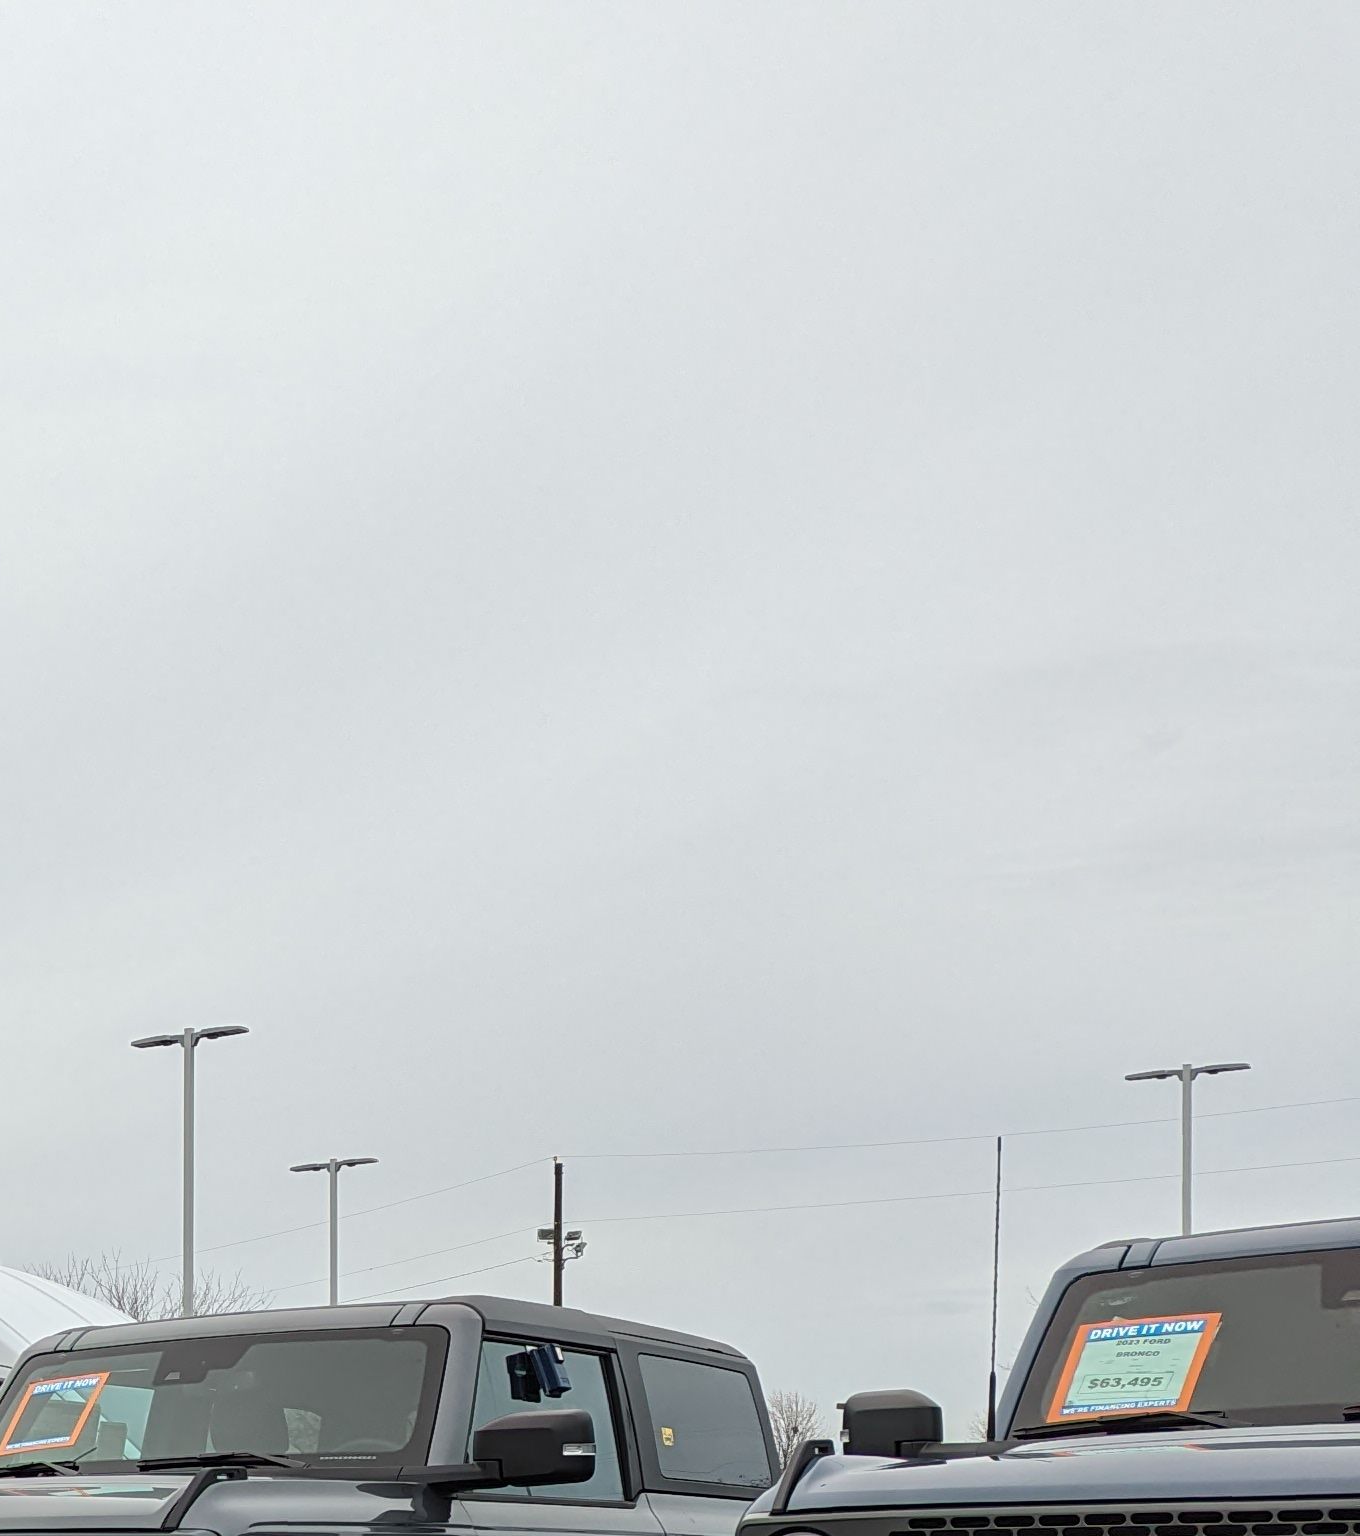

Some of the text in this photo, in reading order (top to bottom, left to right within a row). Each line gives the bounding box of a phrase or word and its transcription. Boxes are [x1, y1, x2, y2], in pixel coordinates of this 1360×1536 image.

[1090, 1320, 1204, 1340] DRIVE IT NOW
[1115, 1350, 1161, 1358] BRONCO
[34, 1377, 99, 1393] DRIVE IT NOW
[1087, 1376, 1164, 1390] $63,495
